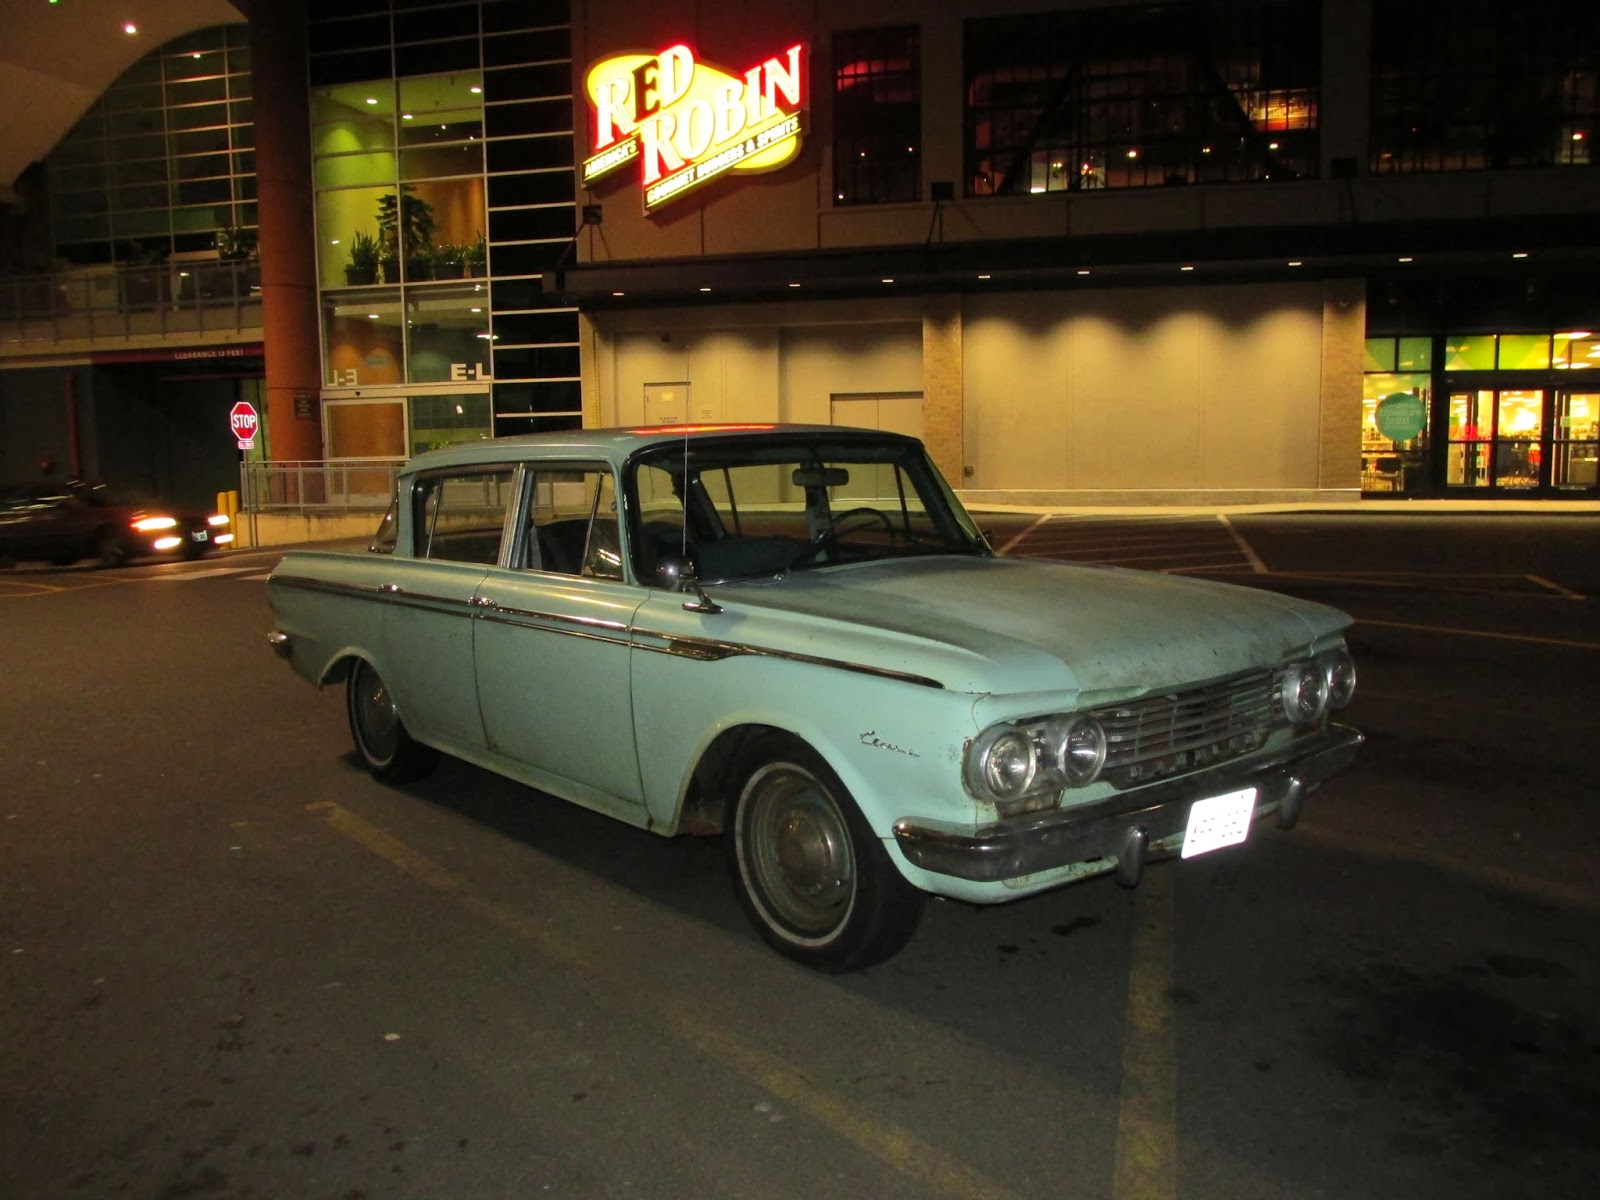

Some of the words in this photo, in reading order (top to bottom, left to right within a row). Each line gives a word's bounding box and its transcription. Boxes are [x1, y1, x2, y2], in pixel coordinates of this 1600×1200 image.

[596, 44, 695, 149] RED
[640, 44, 802, 185] ROBIN
[233, 413, 256, 429] STOP
